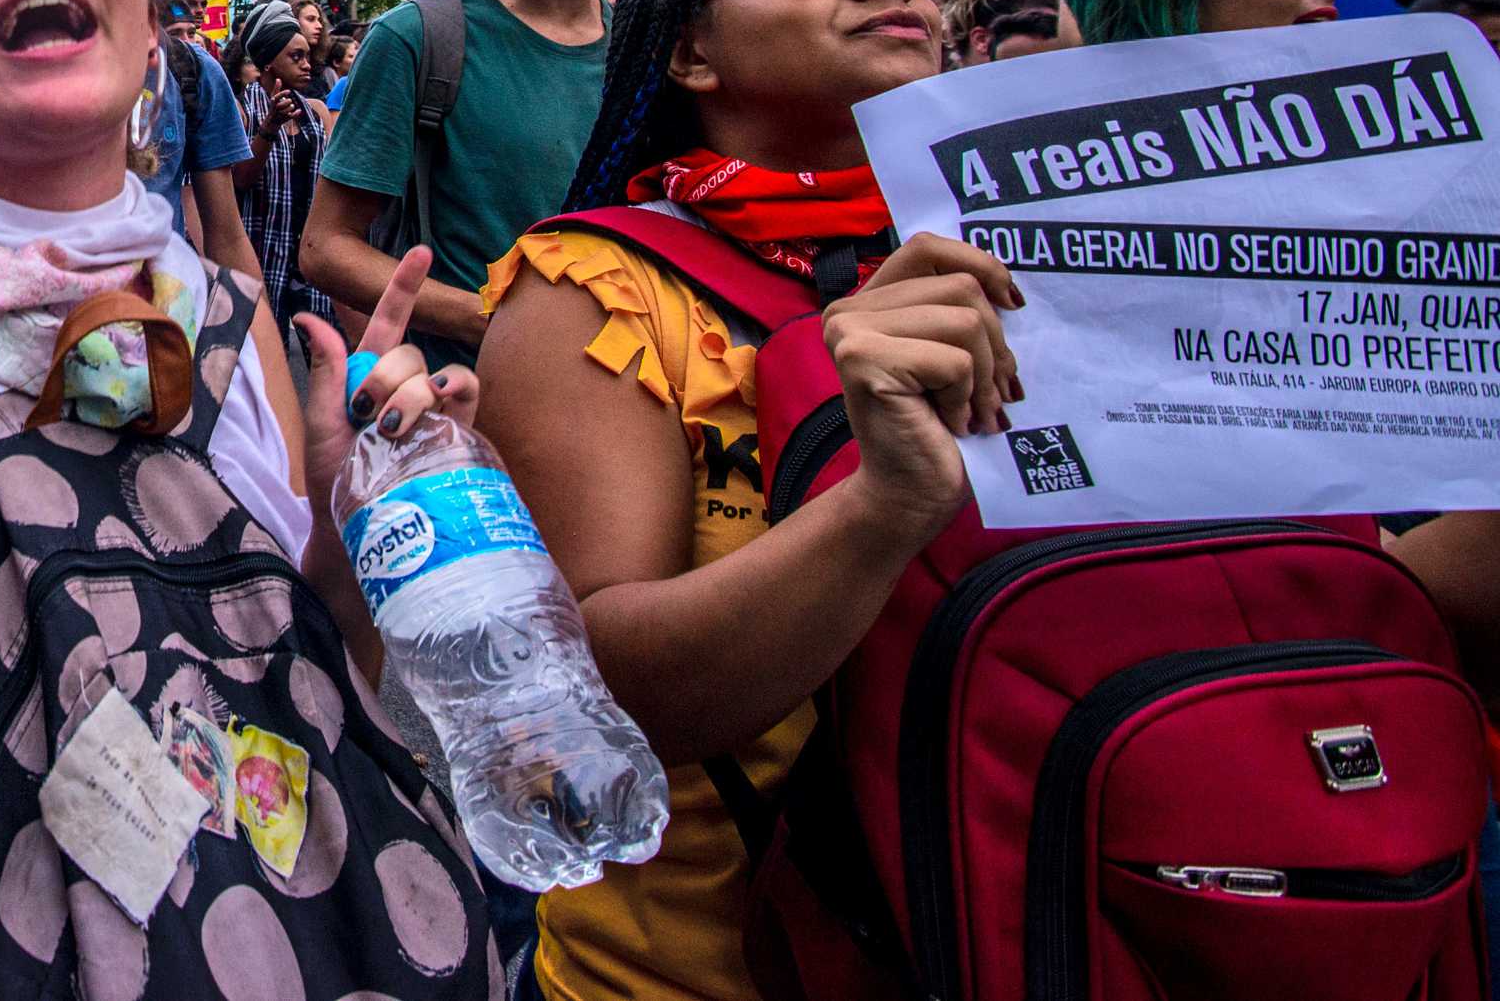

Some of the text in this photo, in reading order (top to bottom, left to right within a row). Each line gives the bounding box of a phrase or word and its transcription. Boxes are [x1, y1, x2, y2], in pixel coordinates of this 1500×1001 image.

[961, 58, 1469, 201] 4 reais NÃO DÁ!
[968, 226, 1055, 266] COLA
[1061, 228, 1168, 270] GERAL
[1173, 231, 1221, 272] NO
[1230, 233, 1384, 277] SEGUNDO
[1298, 290, 1408, 332] 17.JAN,
[1173, 328, 1214, 362] NA
[1224, 330, 1301, 366] CASA
[1311, 333, 1351, 368] DO
[1211, 371, 1237, 387] RUA
[1240, 370, 1280, 389] ITÁLIA,
[1283, 374, 1306, 389] 414
[1319, 375, 1367, 392] JARDIM
[1370, 377, 1421, 395] EUROPA
[1425, 379, 1478, 397] (BAIRRO
[1139, 413, 1156, 424] QUE
[1158, 414, 1191, 425] PASSAM
[1193, 415, 1205, 426] NA
[1331, 421, 1347, 433] DAS
[1388, 425, 1430, 436] HEBRAICA
[1162, 403, 1217, 415] CAMINHANDO
[1218, 405, 1235, 416] DAS
[1277, 408, 1300, 420] FARIA
[1303, 409, 1322, 421] LIMA
[1333, 411, 1373, 423] FRADIQUE
[1376, 413, 1418, 425] COUTINHO
[1420, 415, 1432, 425] DO
[1026, 462, 1080, 481] PASSE
[1030, 474, 1085, 493] LIVRE
[708, 500, 752, 519] Por
[359, 511, 427, 575] crystal
